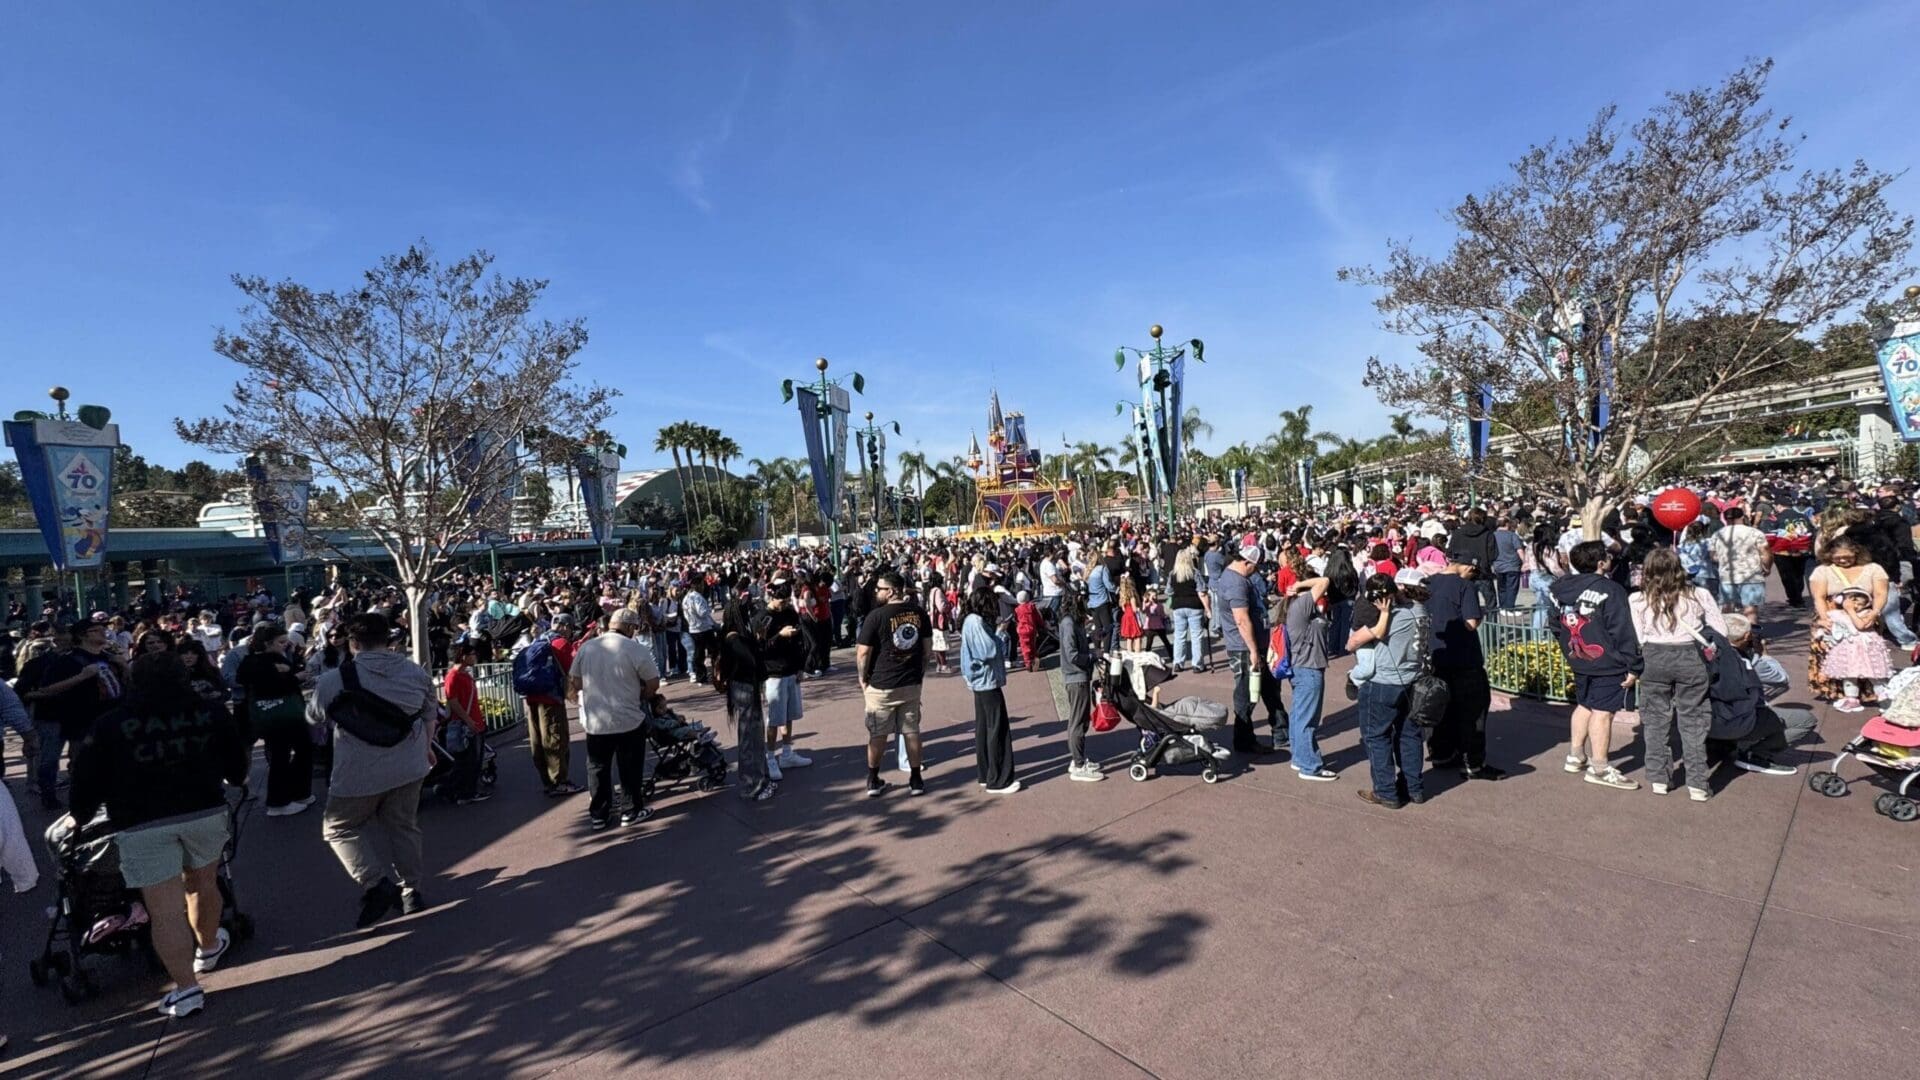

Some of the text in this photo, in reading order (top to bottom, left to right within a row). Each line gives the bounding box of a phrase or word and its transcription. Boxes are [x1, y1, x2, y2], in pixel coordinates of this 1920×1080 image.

[1892, 360, 1918, 374] 70
[67, 474, 97, 489] 70
[120, 712, 214, 740] PARK
[133, 733, 214, 763] CITY
